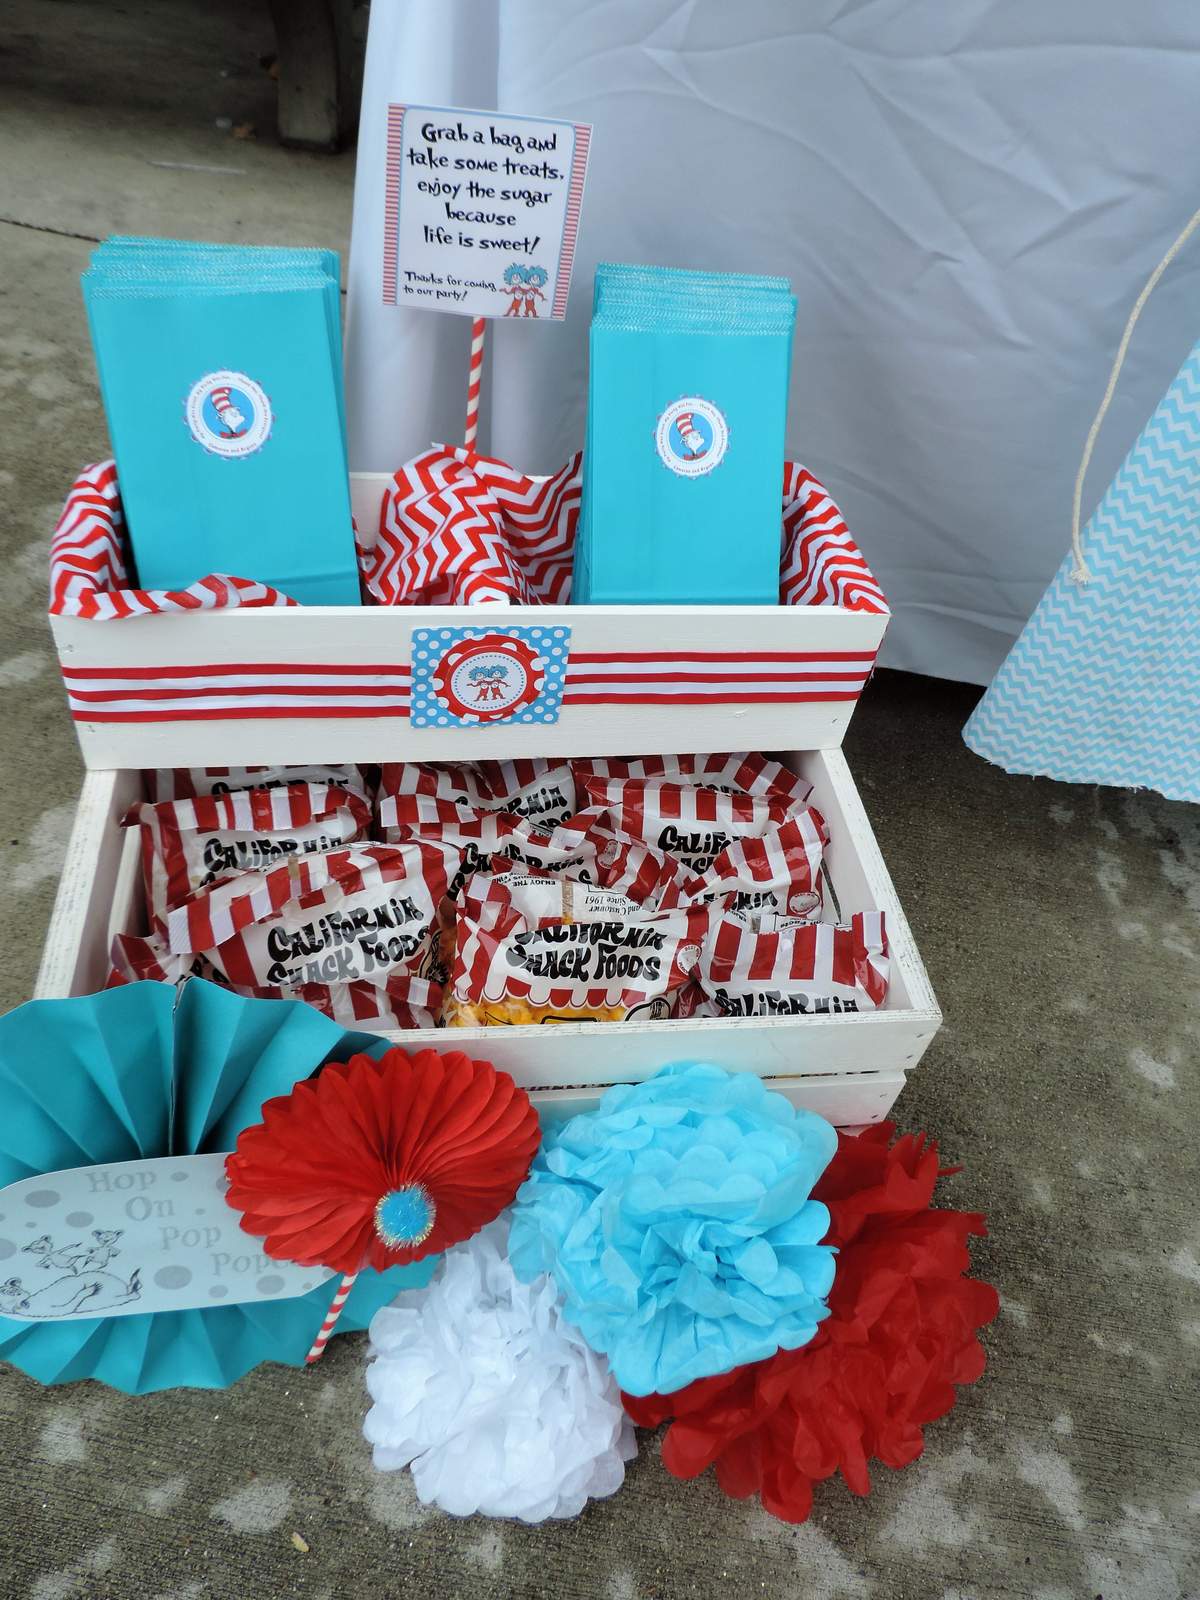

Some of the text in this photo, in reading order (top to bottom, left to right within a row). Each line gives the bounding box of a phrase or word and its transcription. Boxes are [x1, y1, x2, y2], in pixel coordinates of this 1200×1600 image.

[421, 123, 556, 153] Grab a bag and
[406, 147, 449, 170] take
[454, 159, 498, 172] some
[417, 178, 552, 208] enjoy the sugar
[445, 202, 517, 226] because
[423, 225, 541, 255] life is sweet!
[403, 285, 468, 302] to our party!
[404, 271, 498, 293] Thanks for coming
[585, 896, 605, 905] 1961
[593, 942, 661, 981] FOODS
[85, 1169, 157, 1193] Hop
[124, 1195, 175, 1222] On
[159, 1226, 222, 1250] Pop
